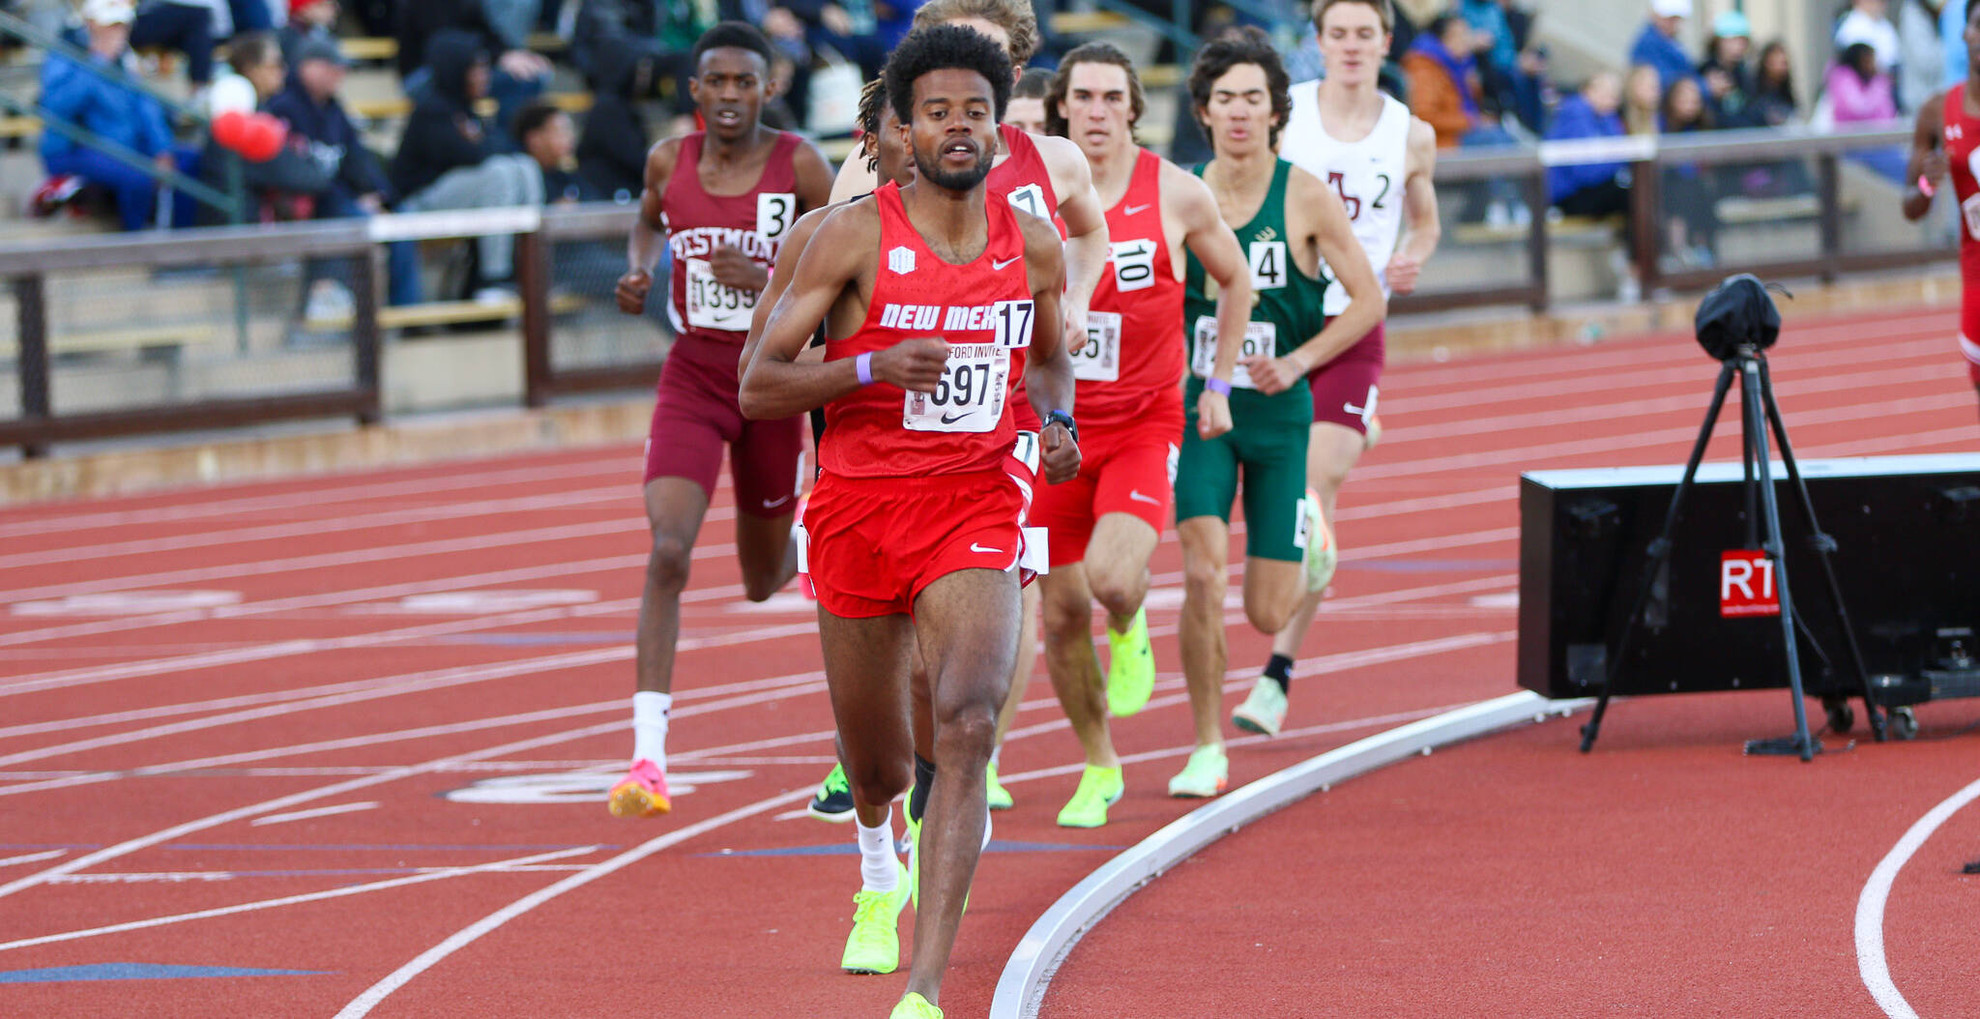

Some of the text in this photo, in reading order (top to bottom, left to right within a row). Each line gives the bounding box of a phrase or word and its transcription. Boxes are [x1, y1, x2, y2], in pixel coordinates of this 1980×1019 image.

[1015, 189, 1037, 217] 7
[1372, 175, 1389, 208] 2
[767, 199, 786, 238] 3
[1117, 245, 1150, 282] 10
[1258, 247, 1279, 284] 4
[879, 303, 941, 331] NEW
[999, 303, 1033, 346] 17
[930, 364, 990, 406] 697
[1721, 558, 1775, 600] RT
